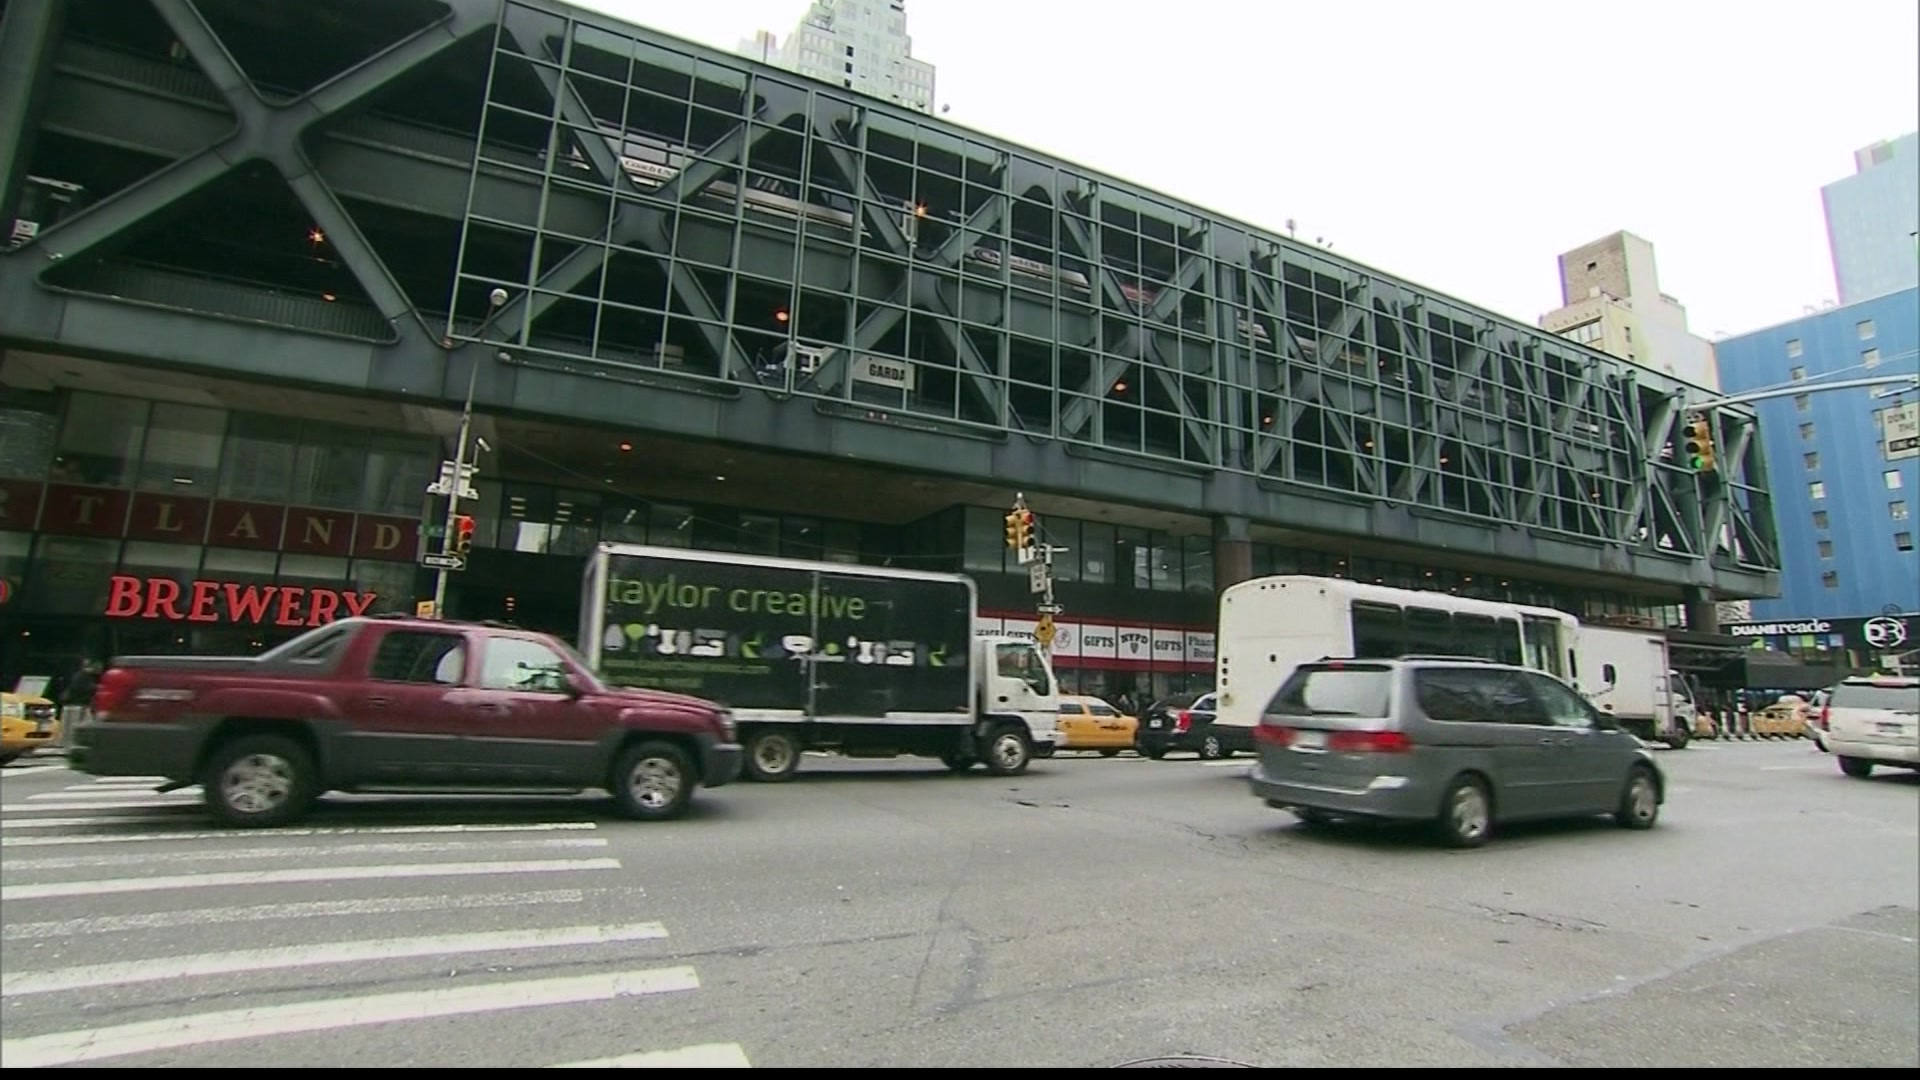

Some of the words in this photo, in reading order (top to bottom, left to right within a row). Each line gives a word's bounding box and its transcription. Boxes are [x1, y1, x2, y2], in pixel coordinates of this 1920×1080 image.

[106, 575, 377, 627] BREWERY
[609, 574, 720, 614] taylor
[1084, 635, 1115, 648] GIFTS
[1154, 640, 1183, 651] GIFTS
